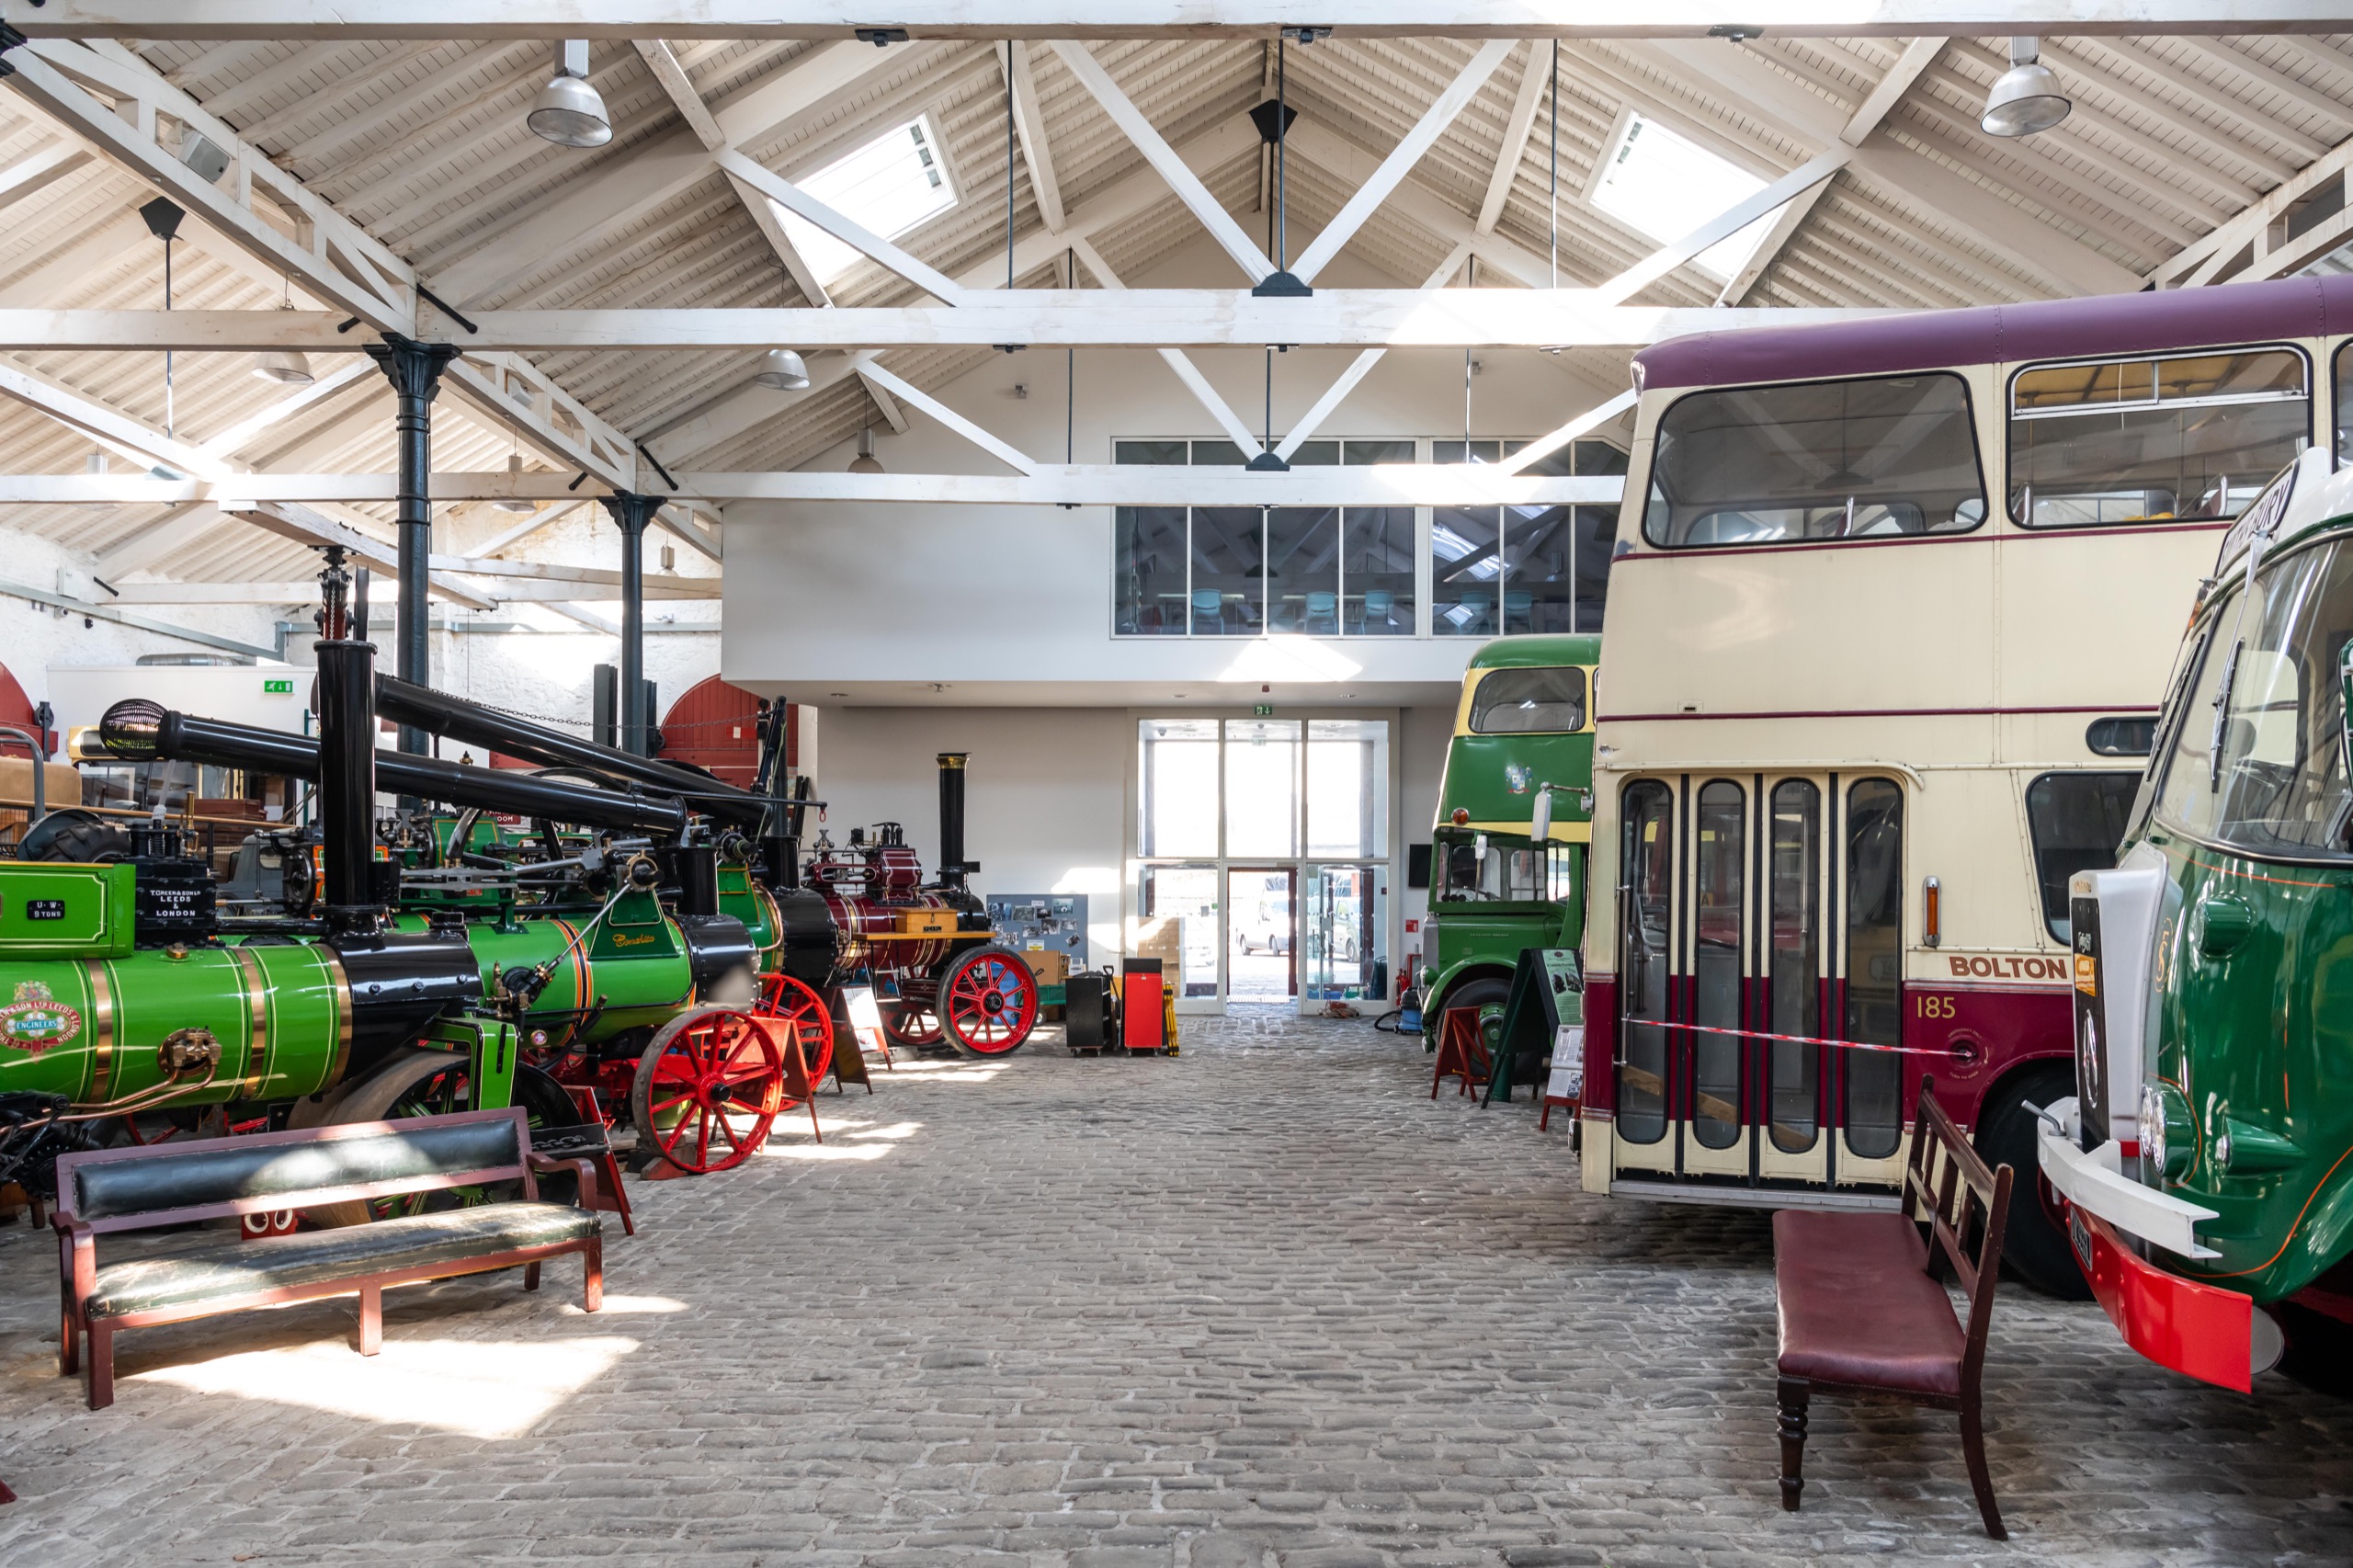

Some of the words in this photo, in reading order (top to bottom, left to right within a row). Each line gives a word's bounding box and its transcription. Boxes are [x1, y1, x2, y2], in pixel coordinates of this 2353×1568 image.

[1949, 956, 2068, 980] BOLTON
[15, 1002, 32, 1011] SON
[49, 1002, 74, 1016] LEEDS
[1917, 995, 1956, 1018] 185
[17, 1020, 57, 1029] ENGINEERS
[56, 1020, 80, 1043] LONDON
